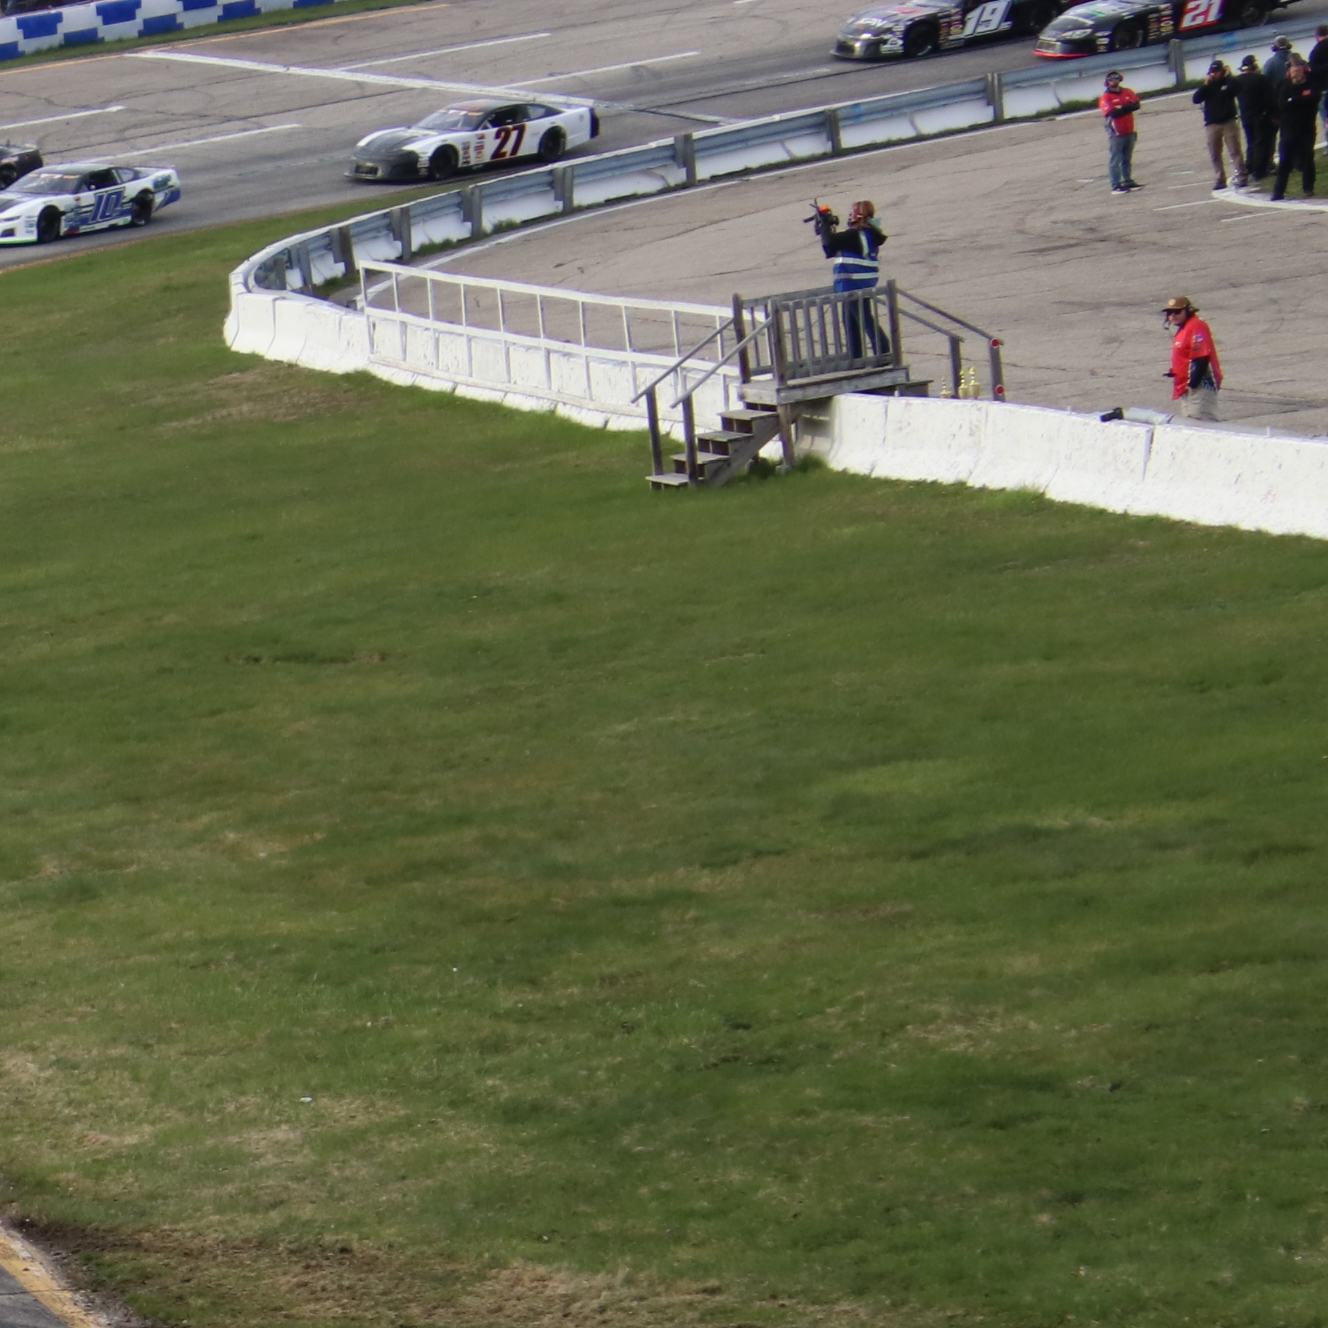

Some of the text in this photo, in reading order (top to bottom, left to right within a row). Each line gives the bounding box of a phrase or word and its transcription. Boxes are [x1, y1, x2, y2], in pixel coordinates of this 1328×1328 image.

[963, 0, 1011, 37] 19
[1179, 0, 1223, 31] 21
[490, 123, 526, 160] 27
[89, 186, 125, 224] 10
